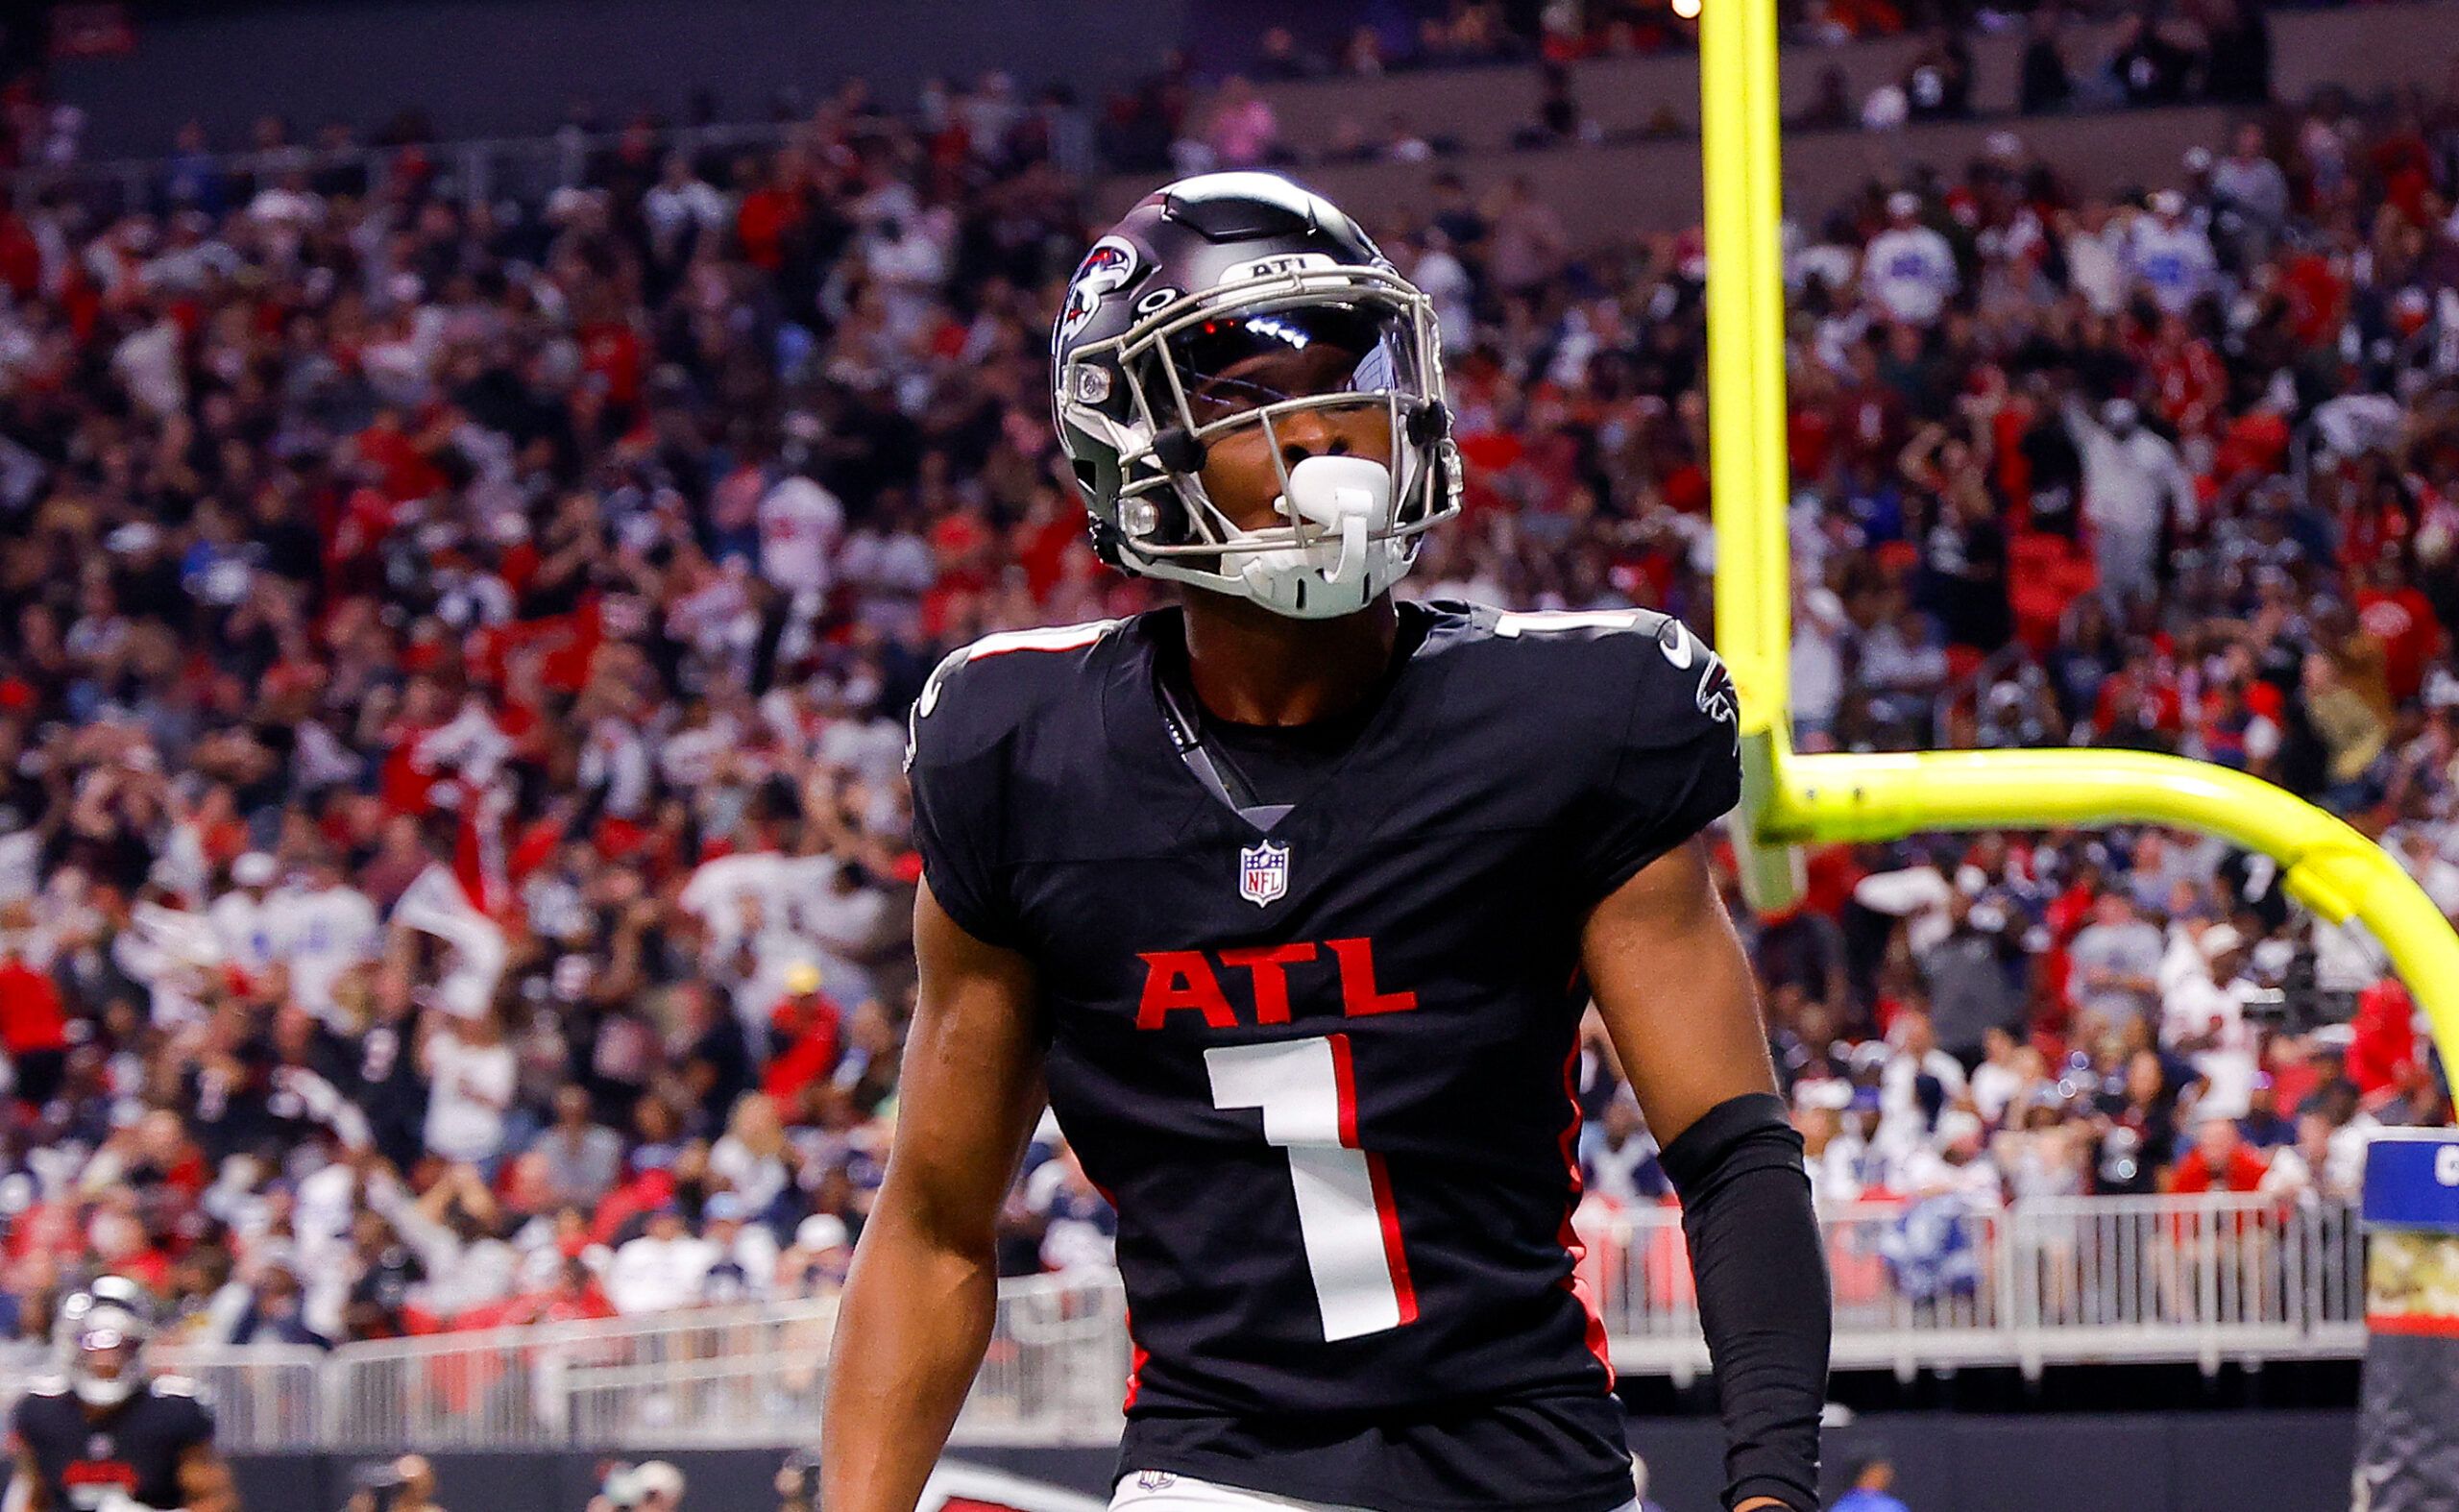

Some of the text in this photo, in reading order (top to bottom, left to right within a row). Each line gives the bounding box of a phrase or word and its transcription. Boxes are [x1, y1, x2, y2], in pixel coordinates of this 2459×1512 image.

[1248, 870, 1279, 894] NFL
[1134, 937, 1420, 1032] ATL
[1203, 1033, 1420, 1343] 1
